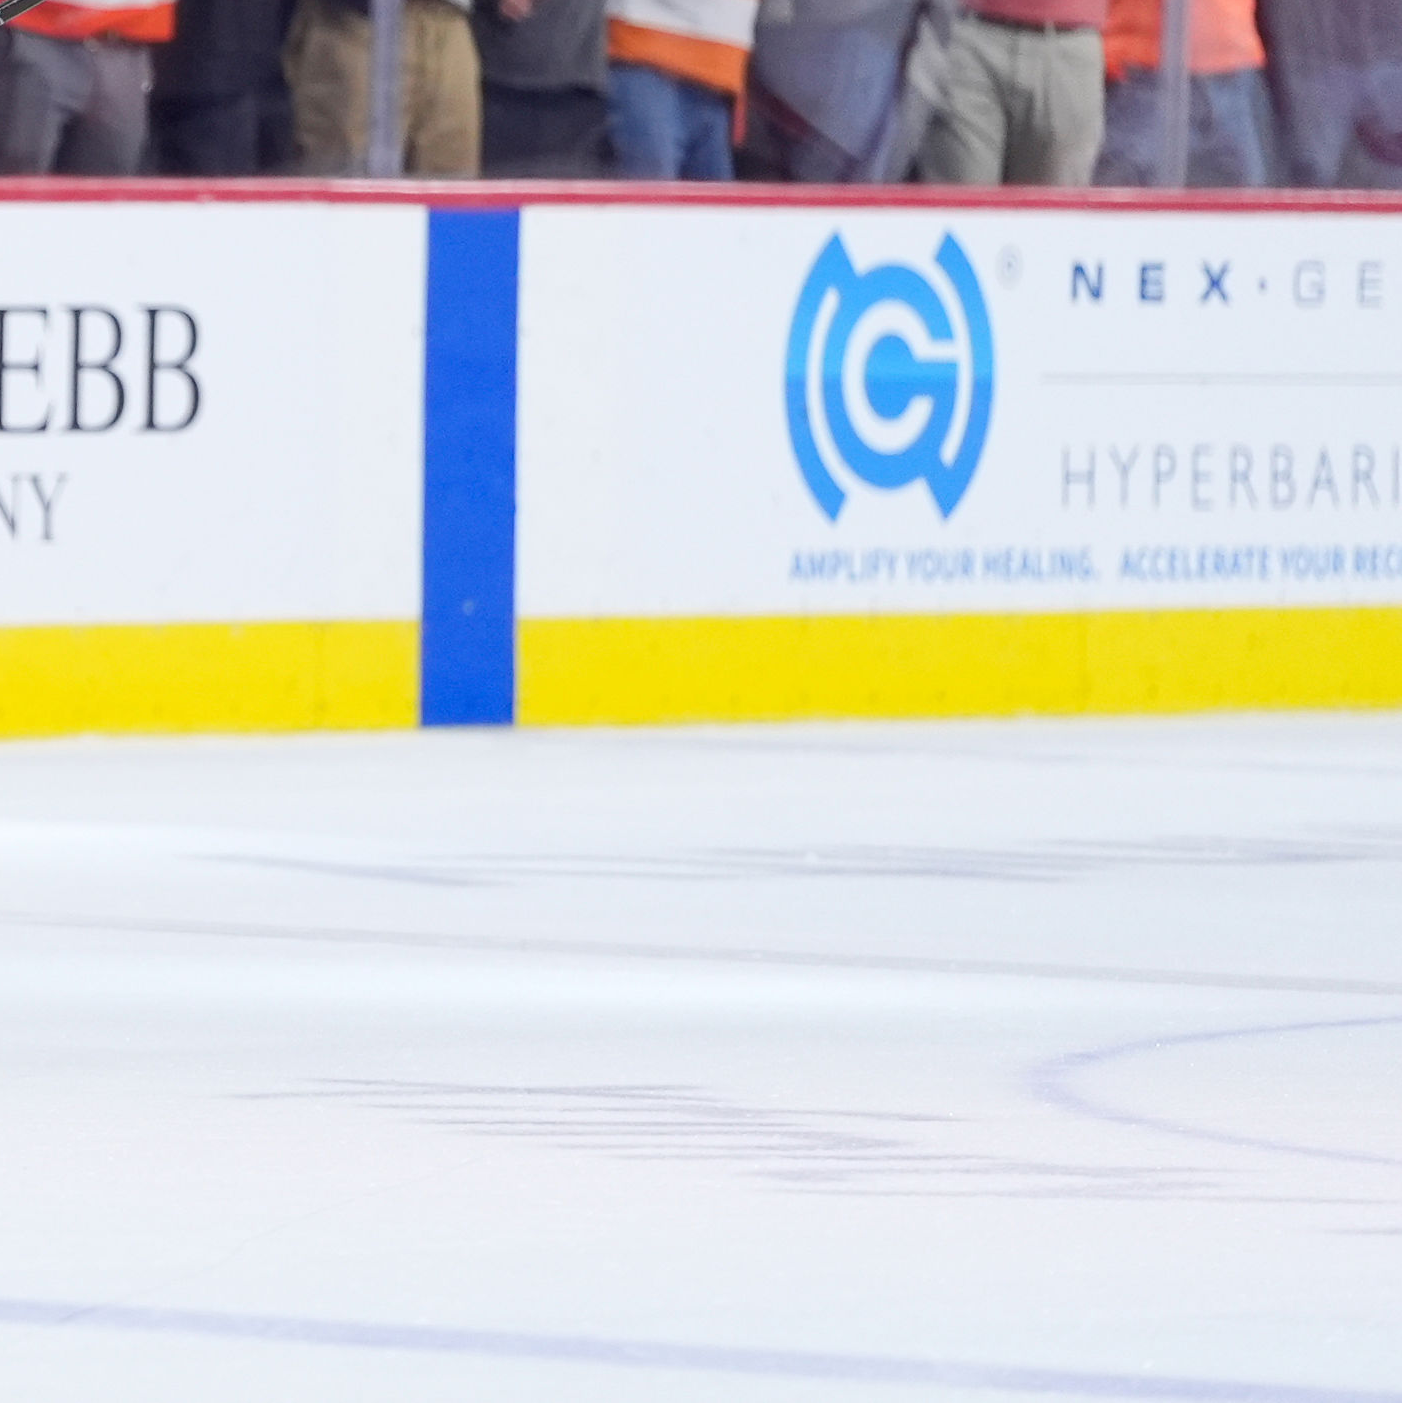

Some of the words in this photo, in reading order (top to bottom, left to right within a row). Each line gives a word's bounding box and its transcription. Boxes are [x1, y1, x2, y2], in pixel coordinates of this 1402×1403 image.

[791, 548, 901, 581] AMPLIFY
[906, 548, 978, 581] YOUR
[1121, 547, 1272, 581] ACCELERATE
[1277, 547, 1345, 581] YOUR
